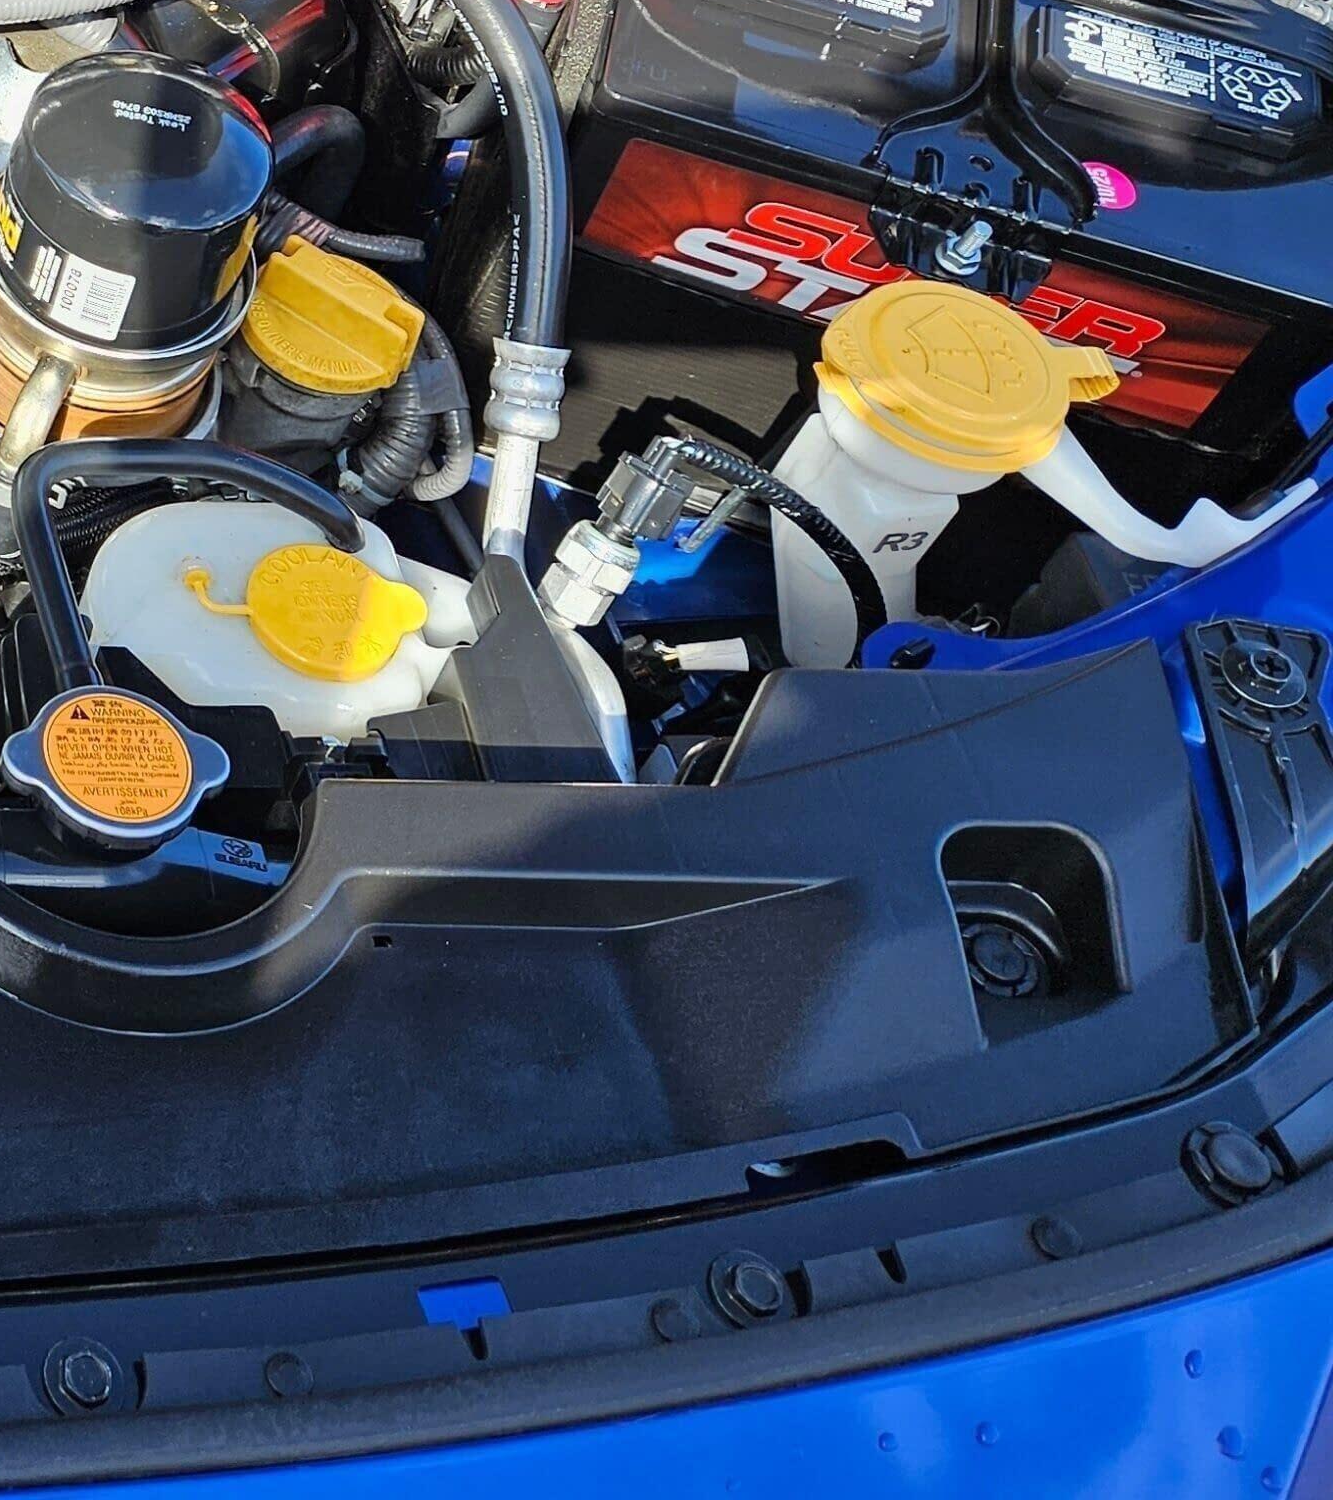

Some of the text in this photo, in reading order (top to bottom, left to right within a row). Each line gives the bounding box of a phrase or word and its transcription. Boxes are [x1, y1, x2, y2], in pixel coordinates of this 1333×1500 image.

[1164, 56, 1186, 69] FAST
[115, 109, 186, 132] Leak Tested
[744, 201, 1166, 357] SUER
[309, 356, 368, 374] MANUAL
[873, 531, 928, 553] R3
[90, 707, 146, 717] WARNING
[57, 743, 173, 753] NEVER OPEN WHEN HOT
[72, 752, 102, 760] JAMAIS
[105, 753, 136, 761] OUVRIR
[147, 754, 175, 762] CHAUD
[83, 787, 168, 798] AVERTISSEMENT
